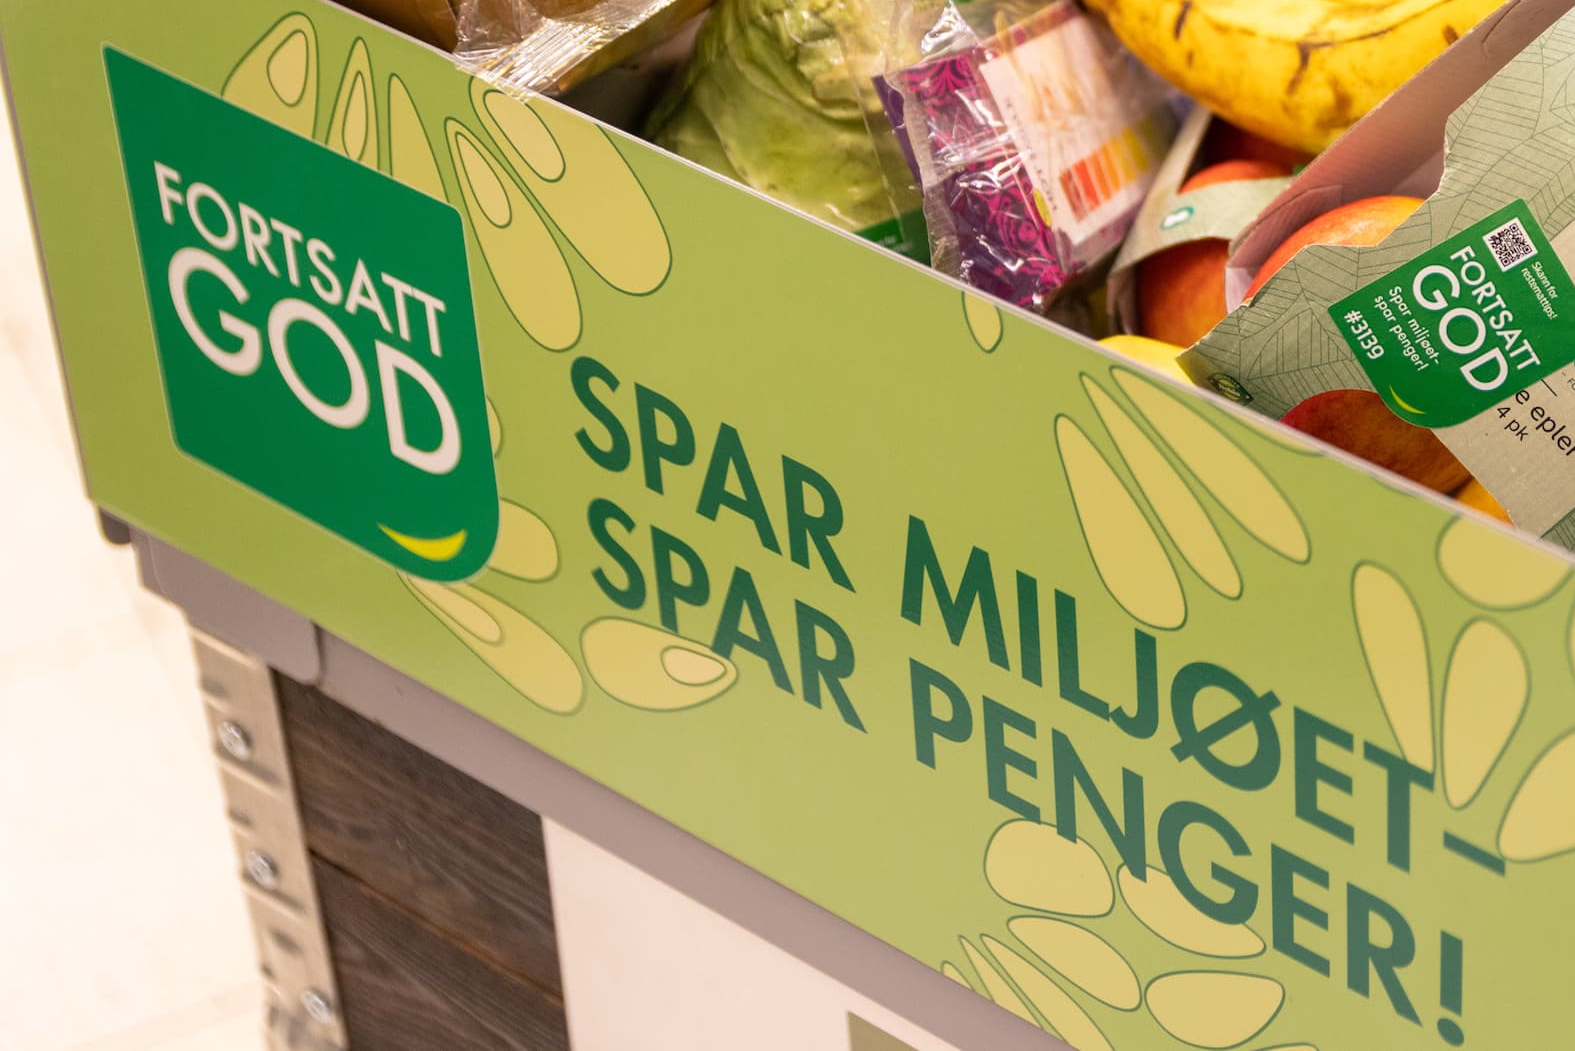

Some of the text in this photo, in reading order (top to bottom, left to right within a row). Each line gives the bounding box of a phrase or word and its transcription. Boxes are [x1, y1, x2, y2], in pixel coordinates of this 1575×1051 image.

[153, 159, 446, 358] FORTSATT
[1450, 245, 1541, 372] FORTSATT
[1521, 267, 1558, 320] restemattips!
[1531, 261, 1551, 288] Skann
[167, 246, 462, 475] GOD
[1343, 309, 1385, 361] #3139
[1374, 294, 1430, 372] spar penger!
[1388, 285, 1440, 365] Spar miljøet-
[1412, 264, 1509, 392] GOD
[570, 356, 857, 595] SPAR
[1496, 405, 1529, 443] 4 pk
[588, 498, 1465, 1046] SPAR PENGER!
